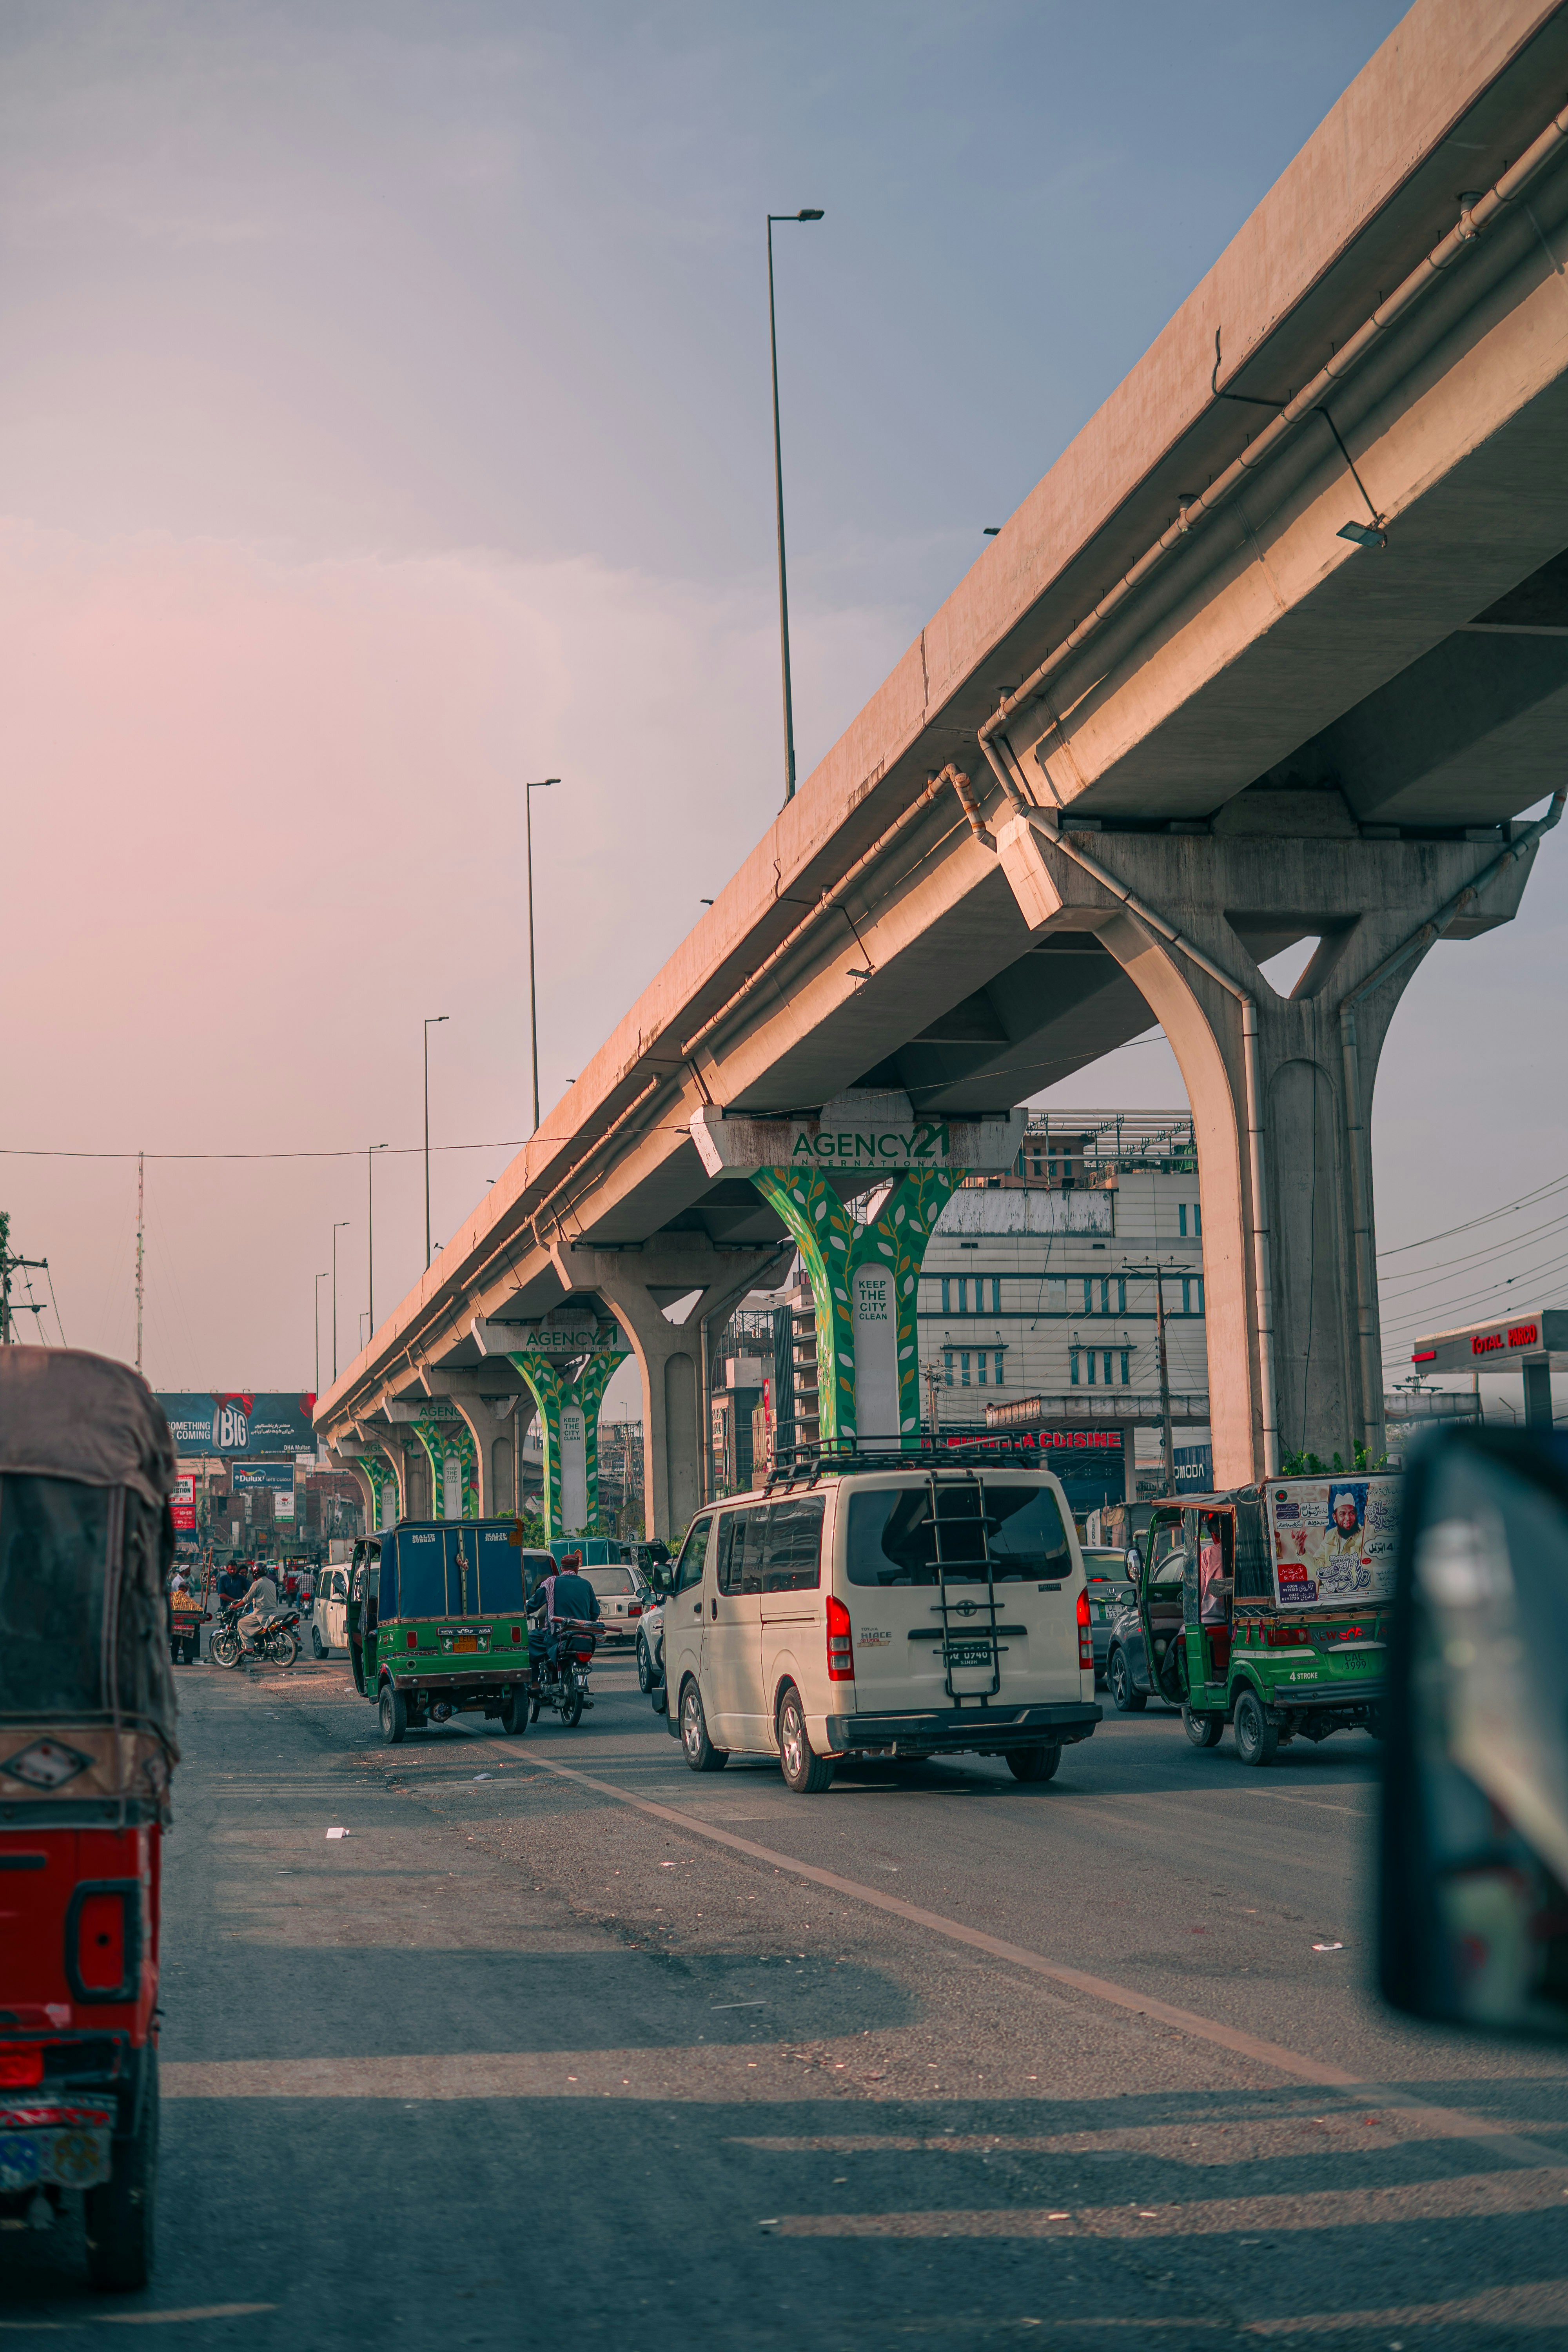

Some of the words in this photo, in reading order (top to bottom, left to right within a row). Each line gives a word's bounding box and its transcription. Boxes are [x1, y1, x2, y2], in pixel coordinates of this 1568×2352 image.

[792, 1159, 951, 1167] INTERNATIONAL
[859, 1280, 886, 1289] KEEP
[859, 1290, 886, 1300] THE
[860, 1302, 886, 1312] CITY
[1508, 1323, 1537, 1347] PARCO
[220, 1407, 247, 1447] BIG
[177, 1431, 211, 1439] COMING
[1039, 1432, 1121, 1448] CUISINE
[1369, 1543, 1385, 1554] اپریل
[1313, 1631, 1337, 1641] NEW
[1345, 1653, 1365, 1661] CAE
[1345, 1661, 1367, 1670] 1999
[1289, 1671, 1296, 1681] 4
